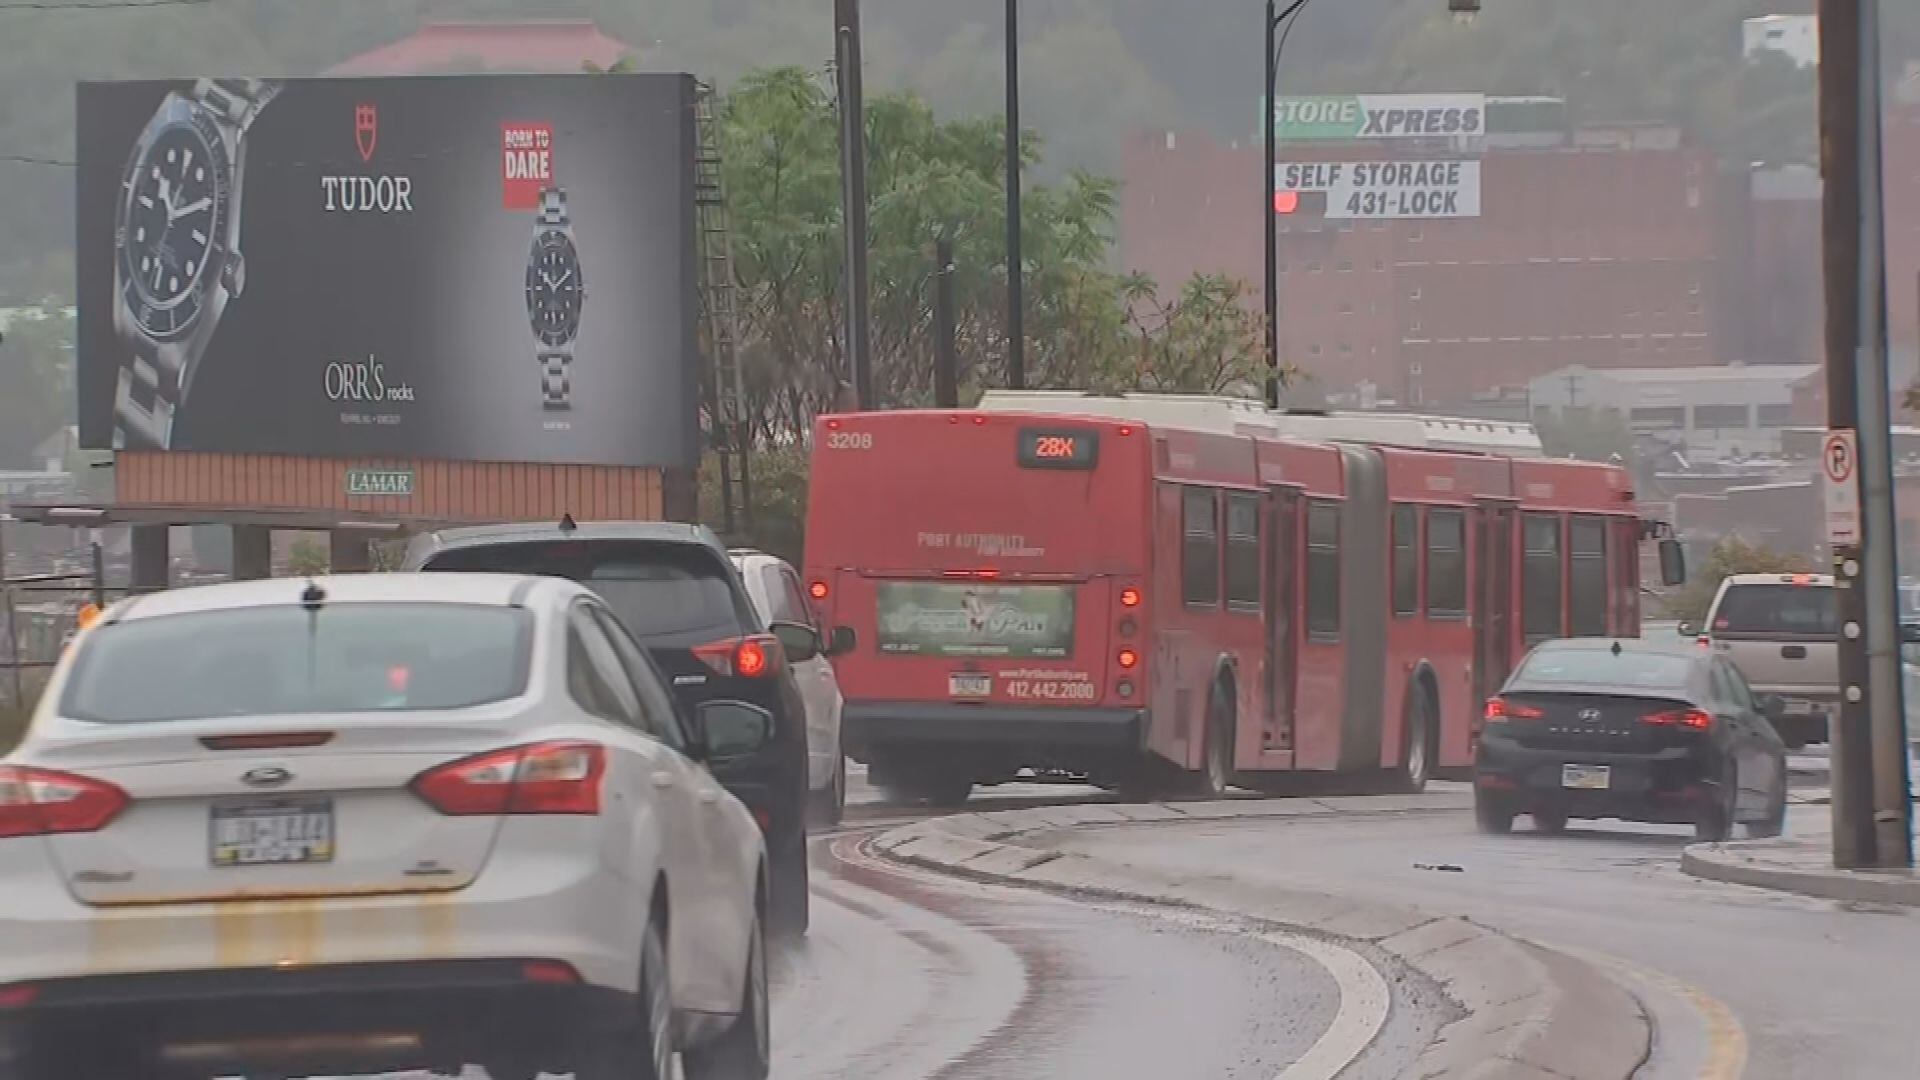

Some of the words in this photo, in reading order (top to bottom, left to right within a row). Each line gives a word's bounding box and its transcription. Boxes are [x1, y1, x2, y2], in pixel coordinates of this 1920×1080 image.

[1273, 100, 1358, 123] STORE
[1364, 108, 1480, 135] XPRESS
[505, 129, 532, 147] BORN
[535, 129, 549, 148] TO
[505, 151, 550, 179] DARE
[1285, 164, 1342, 188] SELF
[1352, 163, 1460, 187] STORAGE
[321, 175, 413, 212] TUDOR
[1346, 191, 1458, 214] 431-LOCK
[325, 353, 384, 400] ORR'S
[827, 432, 873, 449] 3208
[1035, 437, 1074, 457] 28X
[351, 473, 408, 491] LAMAR
[1006, 680, 1094, 699] 412.442.2000
